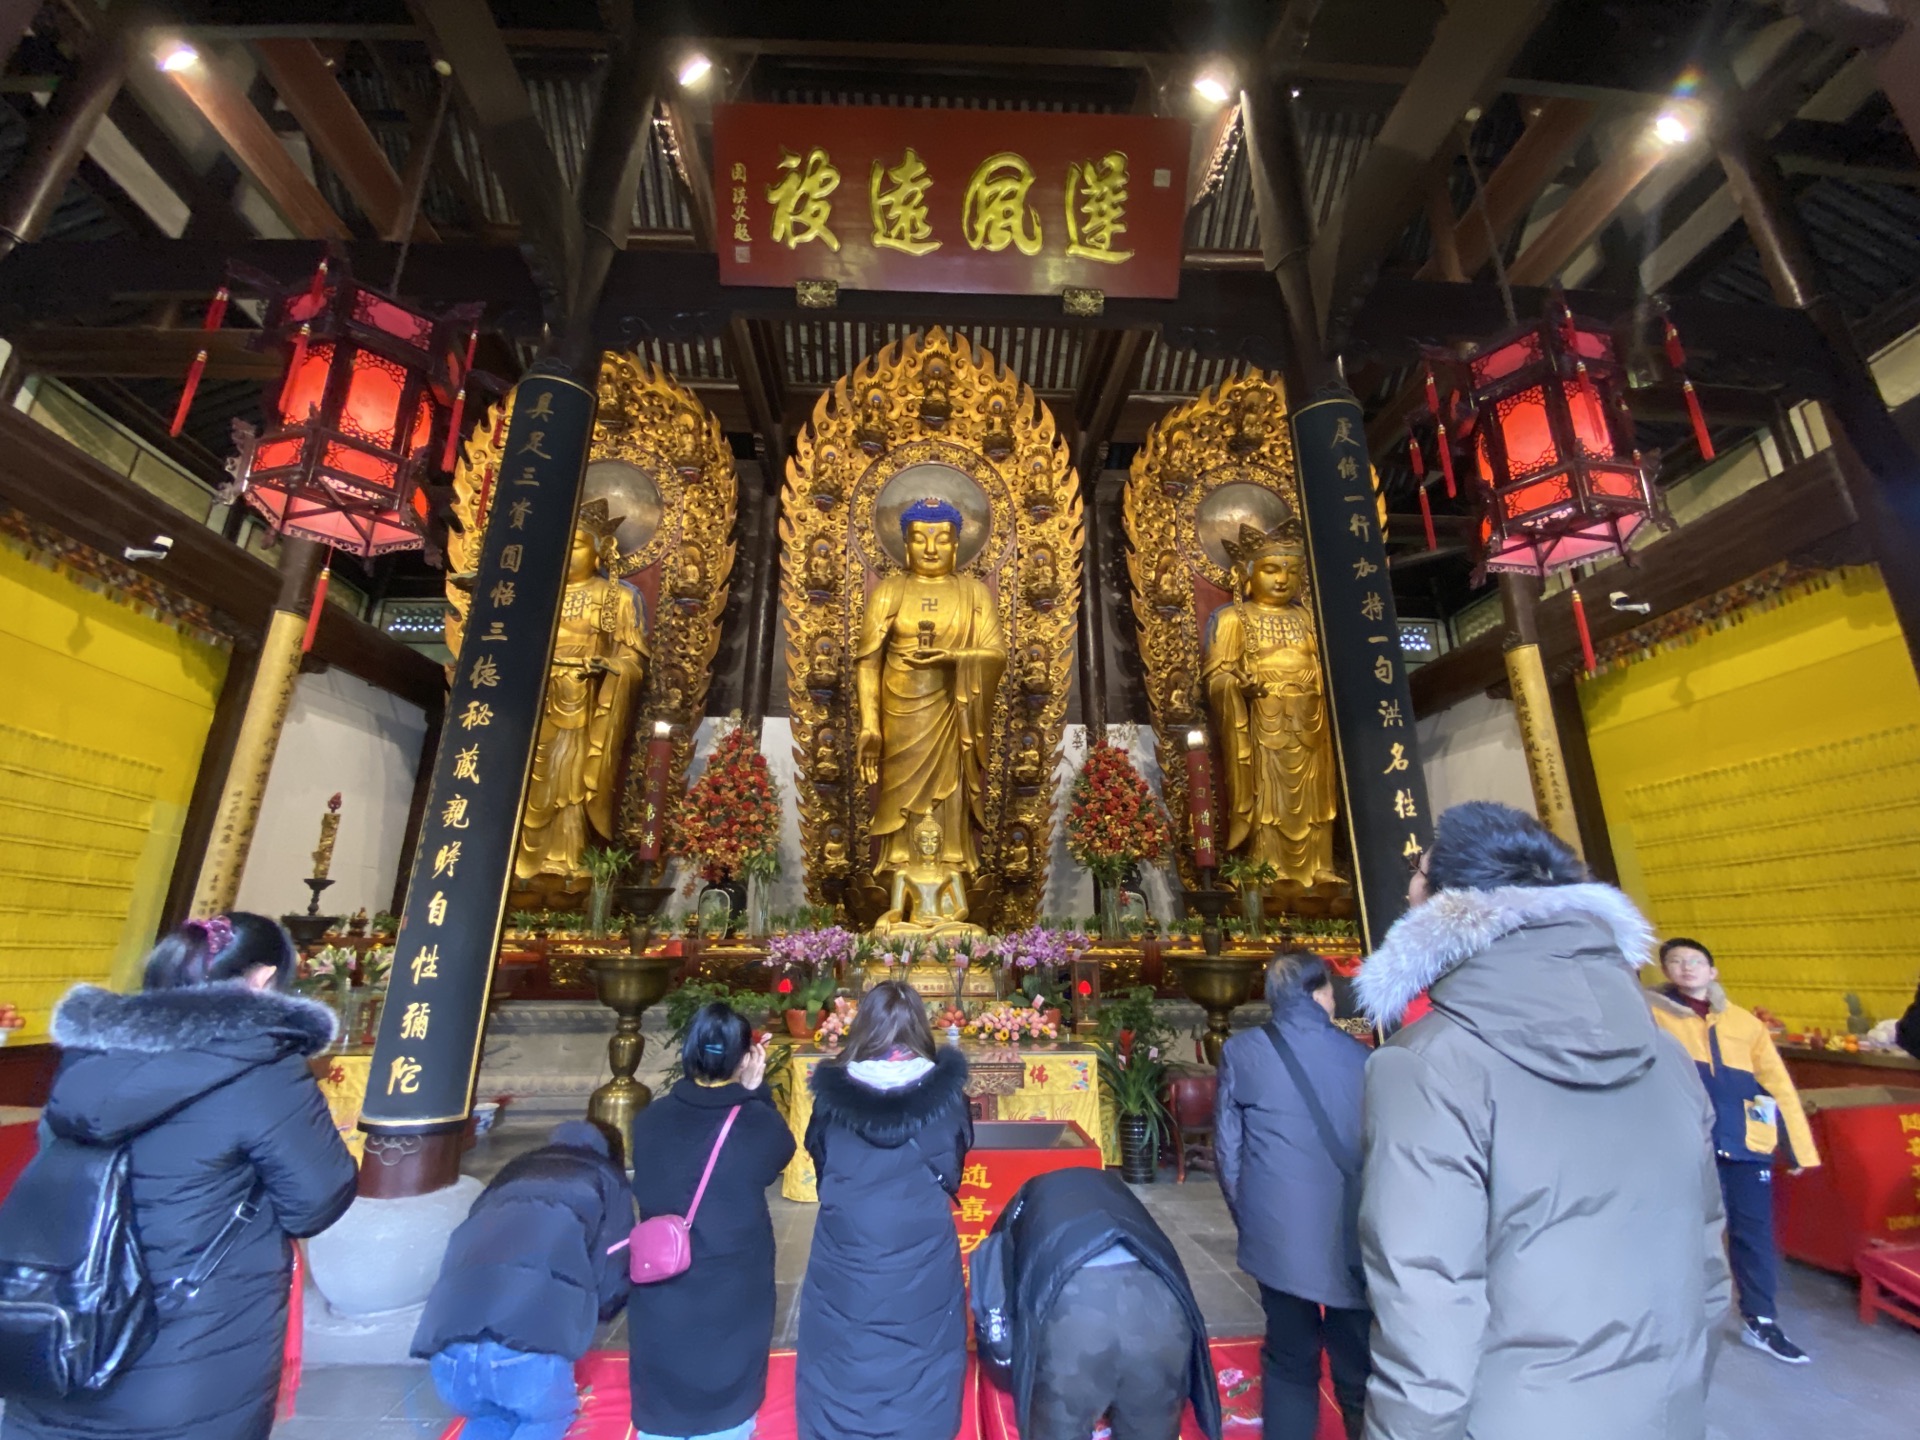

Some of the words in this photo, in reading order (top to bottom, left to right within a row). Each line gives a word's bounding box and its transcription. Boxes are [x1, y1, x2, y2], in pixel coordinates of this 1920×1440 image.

[1029, 1064, 1049, 1089] 佛
[952, 1163, 993, 1288] 随喜功
